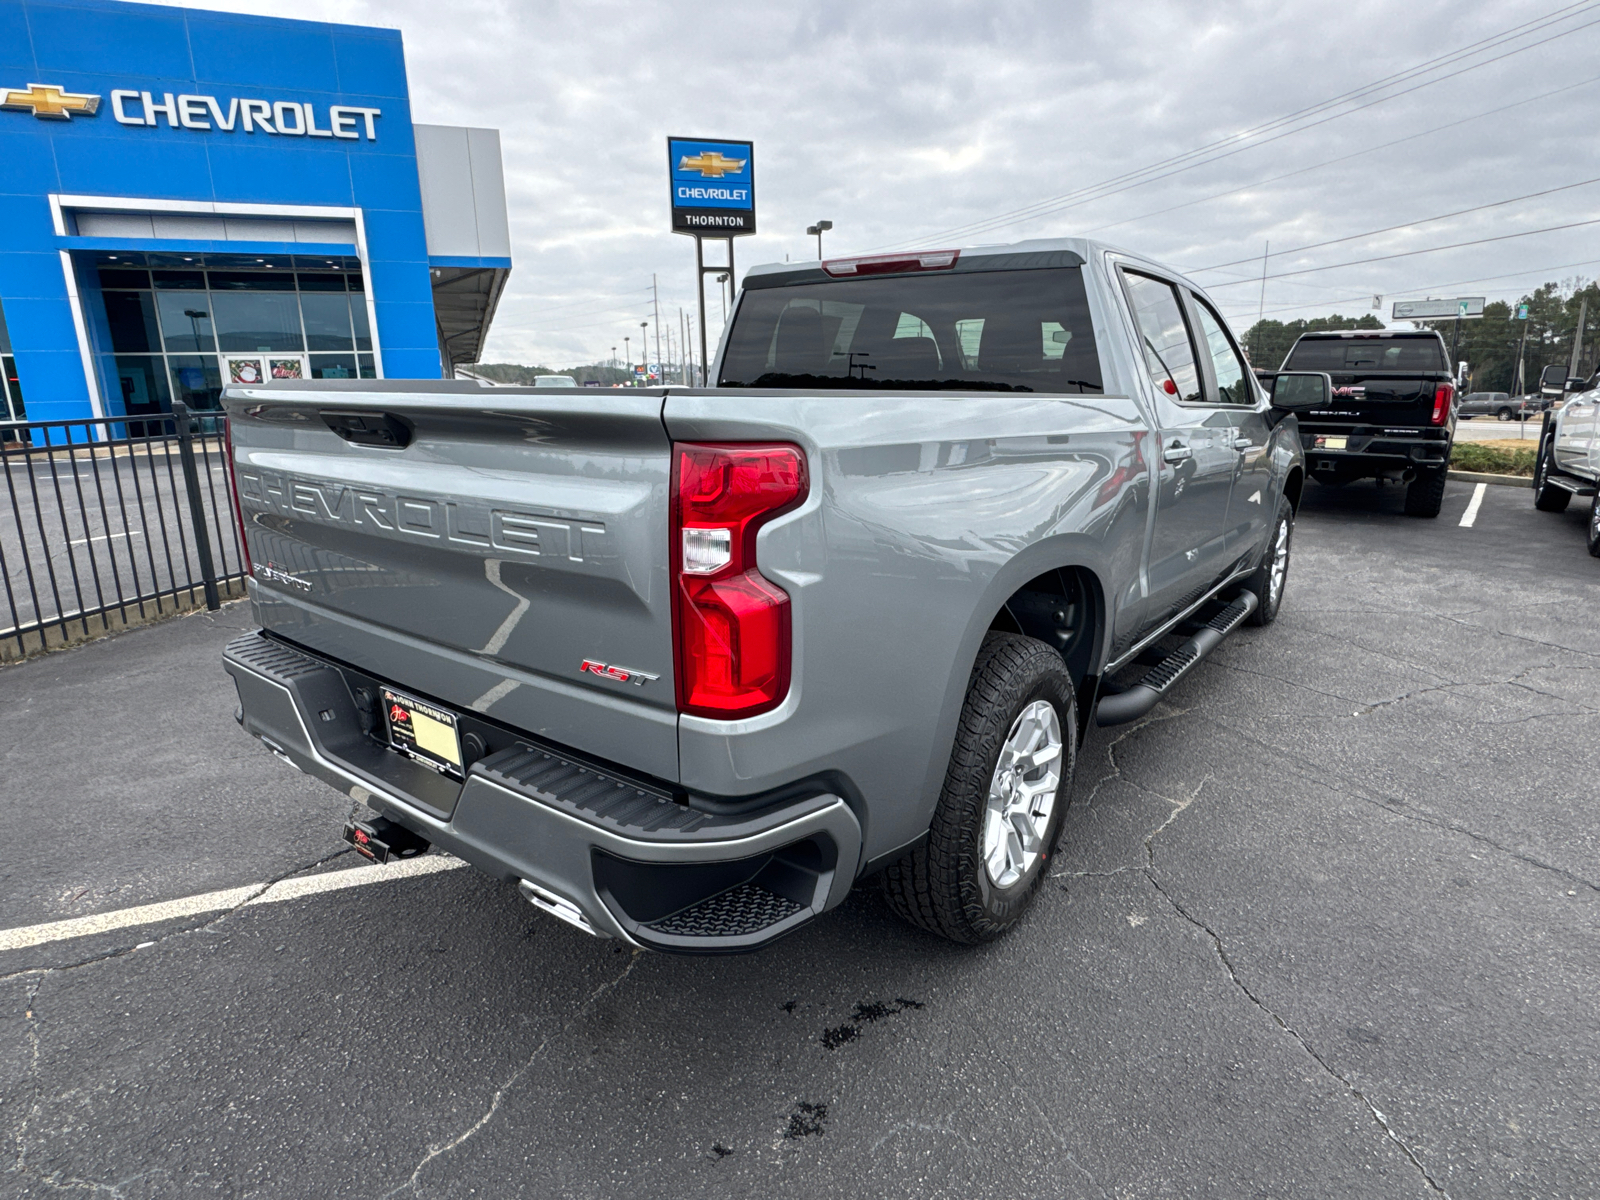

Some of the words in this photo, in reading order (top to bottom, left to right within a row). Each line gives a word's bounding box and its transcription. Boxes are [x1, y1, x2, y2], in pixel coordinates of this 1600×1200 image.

[110, 89, 381, 140] CHEVROLET
[678, 187, 748, 200] CHEVROLET
[685, 215, 744, 227] THORNTON
[1331, 386, 1366, 397] MC
[241, 470, 606, 562] CHEVROLET
[579, 658, 661, 686] RST
[396, 694, 415, 709] JOHN
